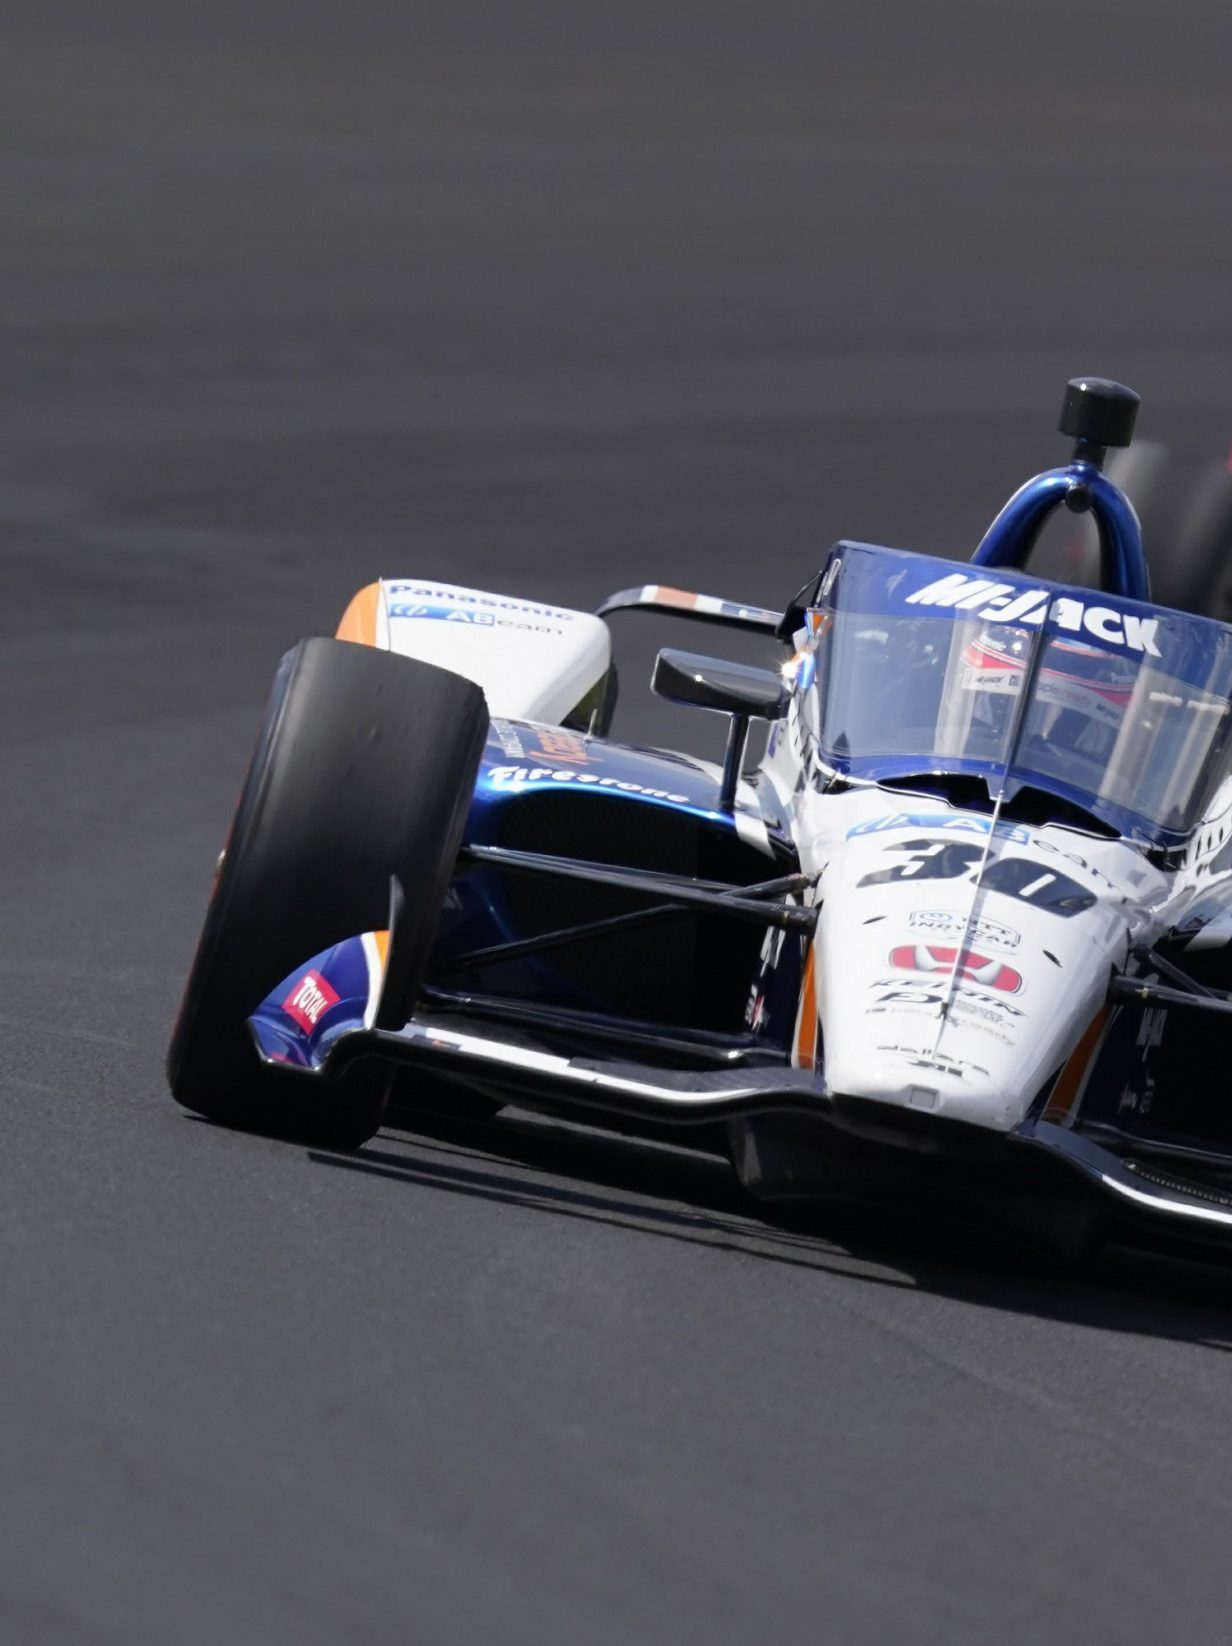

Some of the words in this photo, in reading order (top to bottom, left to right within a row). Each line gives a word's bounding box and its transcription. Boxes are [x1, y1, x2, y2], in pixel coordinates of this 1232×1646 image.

[388, 584, 576, 621] Panasonic
[487, 765, 690, 803] Firestone
[856, 838, 1098, 918] 30
[292, 975, 329, 1025] TOTAL
